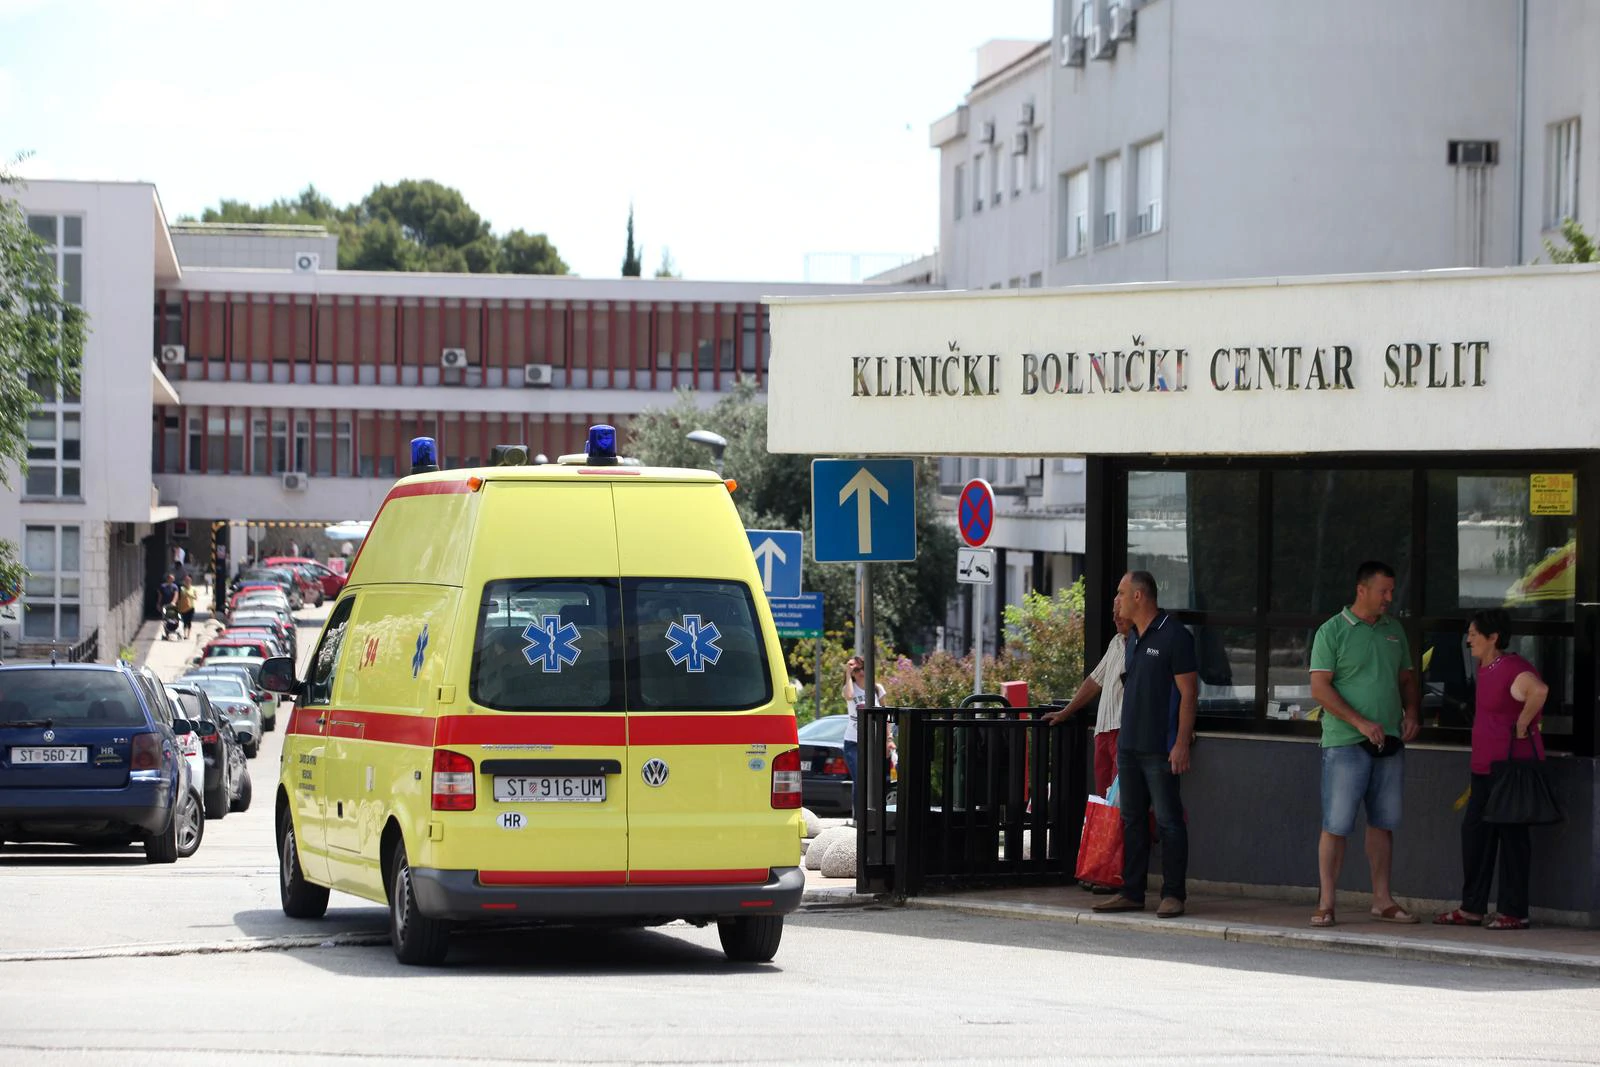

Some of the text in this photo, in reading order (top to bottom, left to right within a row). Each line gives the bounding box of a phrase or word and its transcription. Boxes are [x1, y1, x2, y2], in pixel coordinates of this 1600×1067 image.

[851, 335, 1489, 397] KLINIČKI BOLNIČKI CENTAR SPLIT
[20, 750, 34, 762] ST
[101, 747, 114, 755] HR
[507, 778, 603, 796] ST 916-UM
[503, 813, 521, 828] HR
